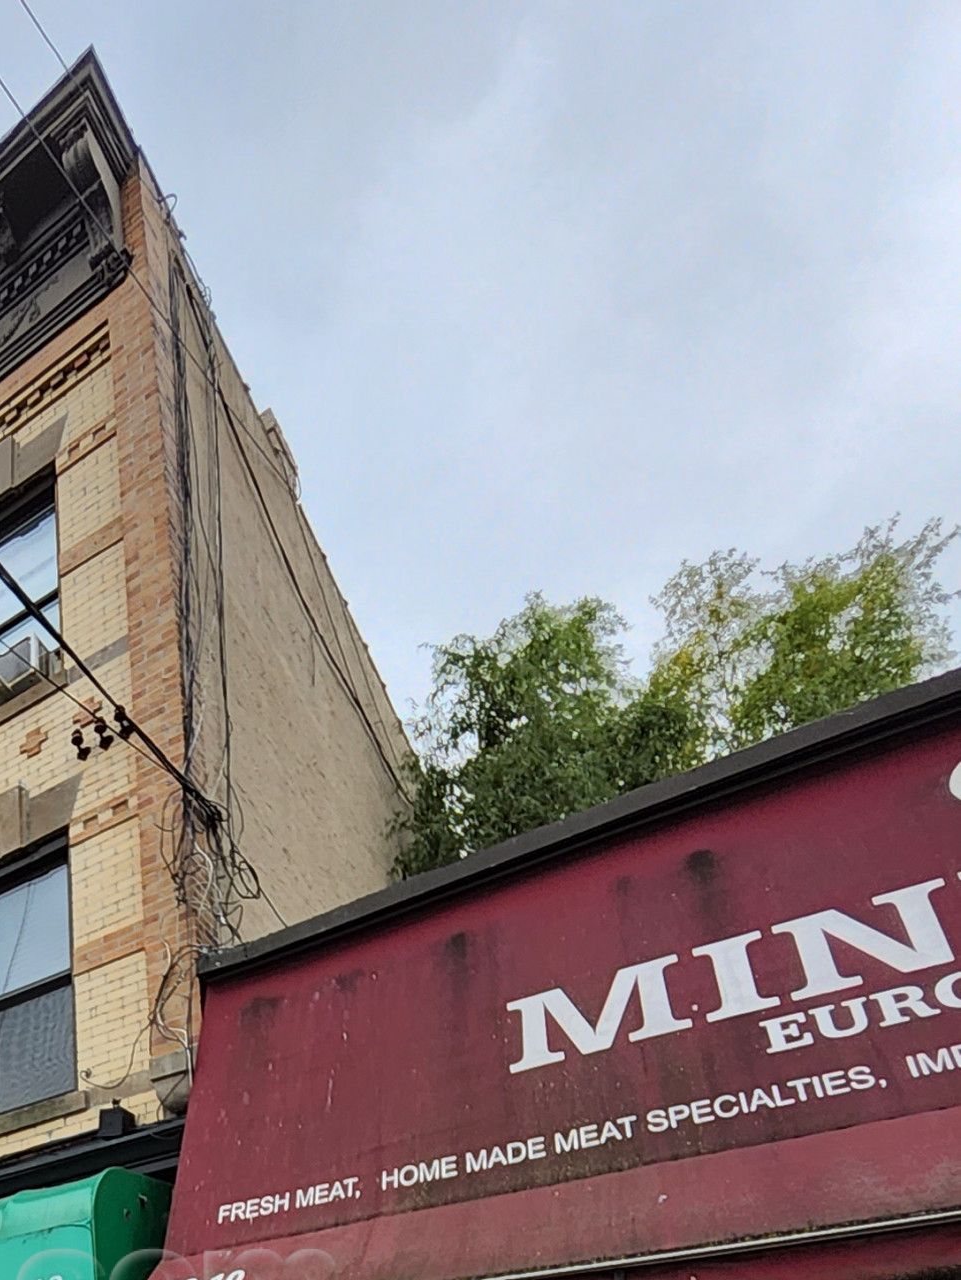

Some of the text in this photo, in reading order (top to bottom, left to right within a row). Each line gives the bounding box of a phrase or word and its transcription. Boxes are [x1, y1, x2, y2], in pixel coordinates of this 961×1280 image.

[506, 873, 961, 1074] MIN
[217, 1191, 291, 1225] FRESH
[295, 1177, 362, 1209] MEAT,
[381, 1156, 459, 1191] HOME
[465, 1136, 546, 1174] MADE
[554, 1115, 638, 1156] MEAT
[646, 1065, 888, 1133] SPECIALTIES,
